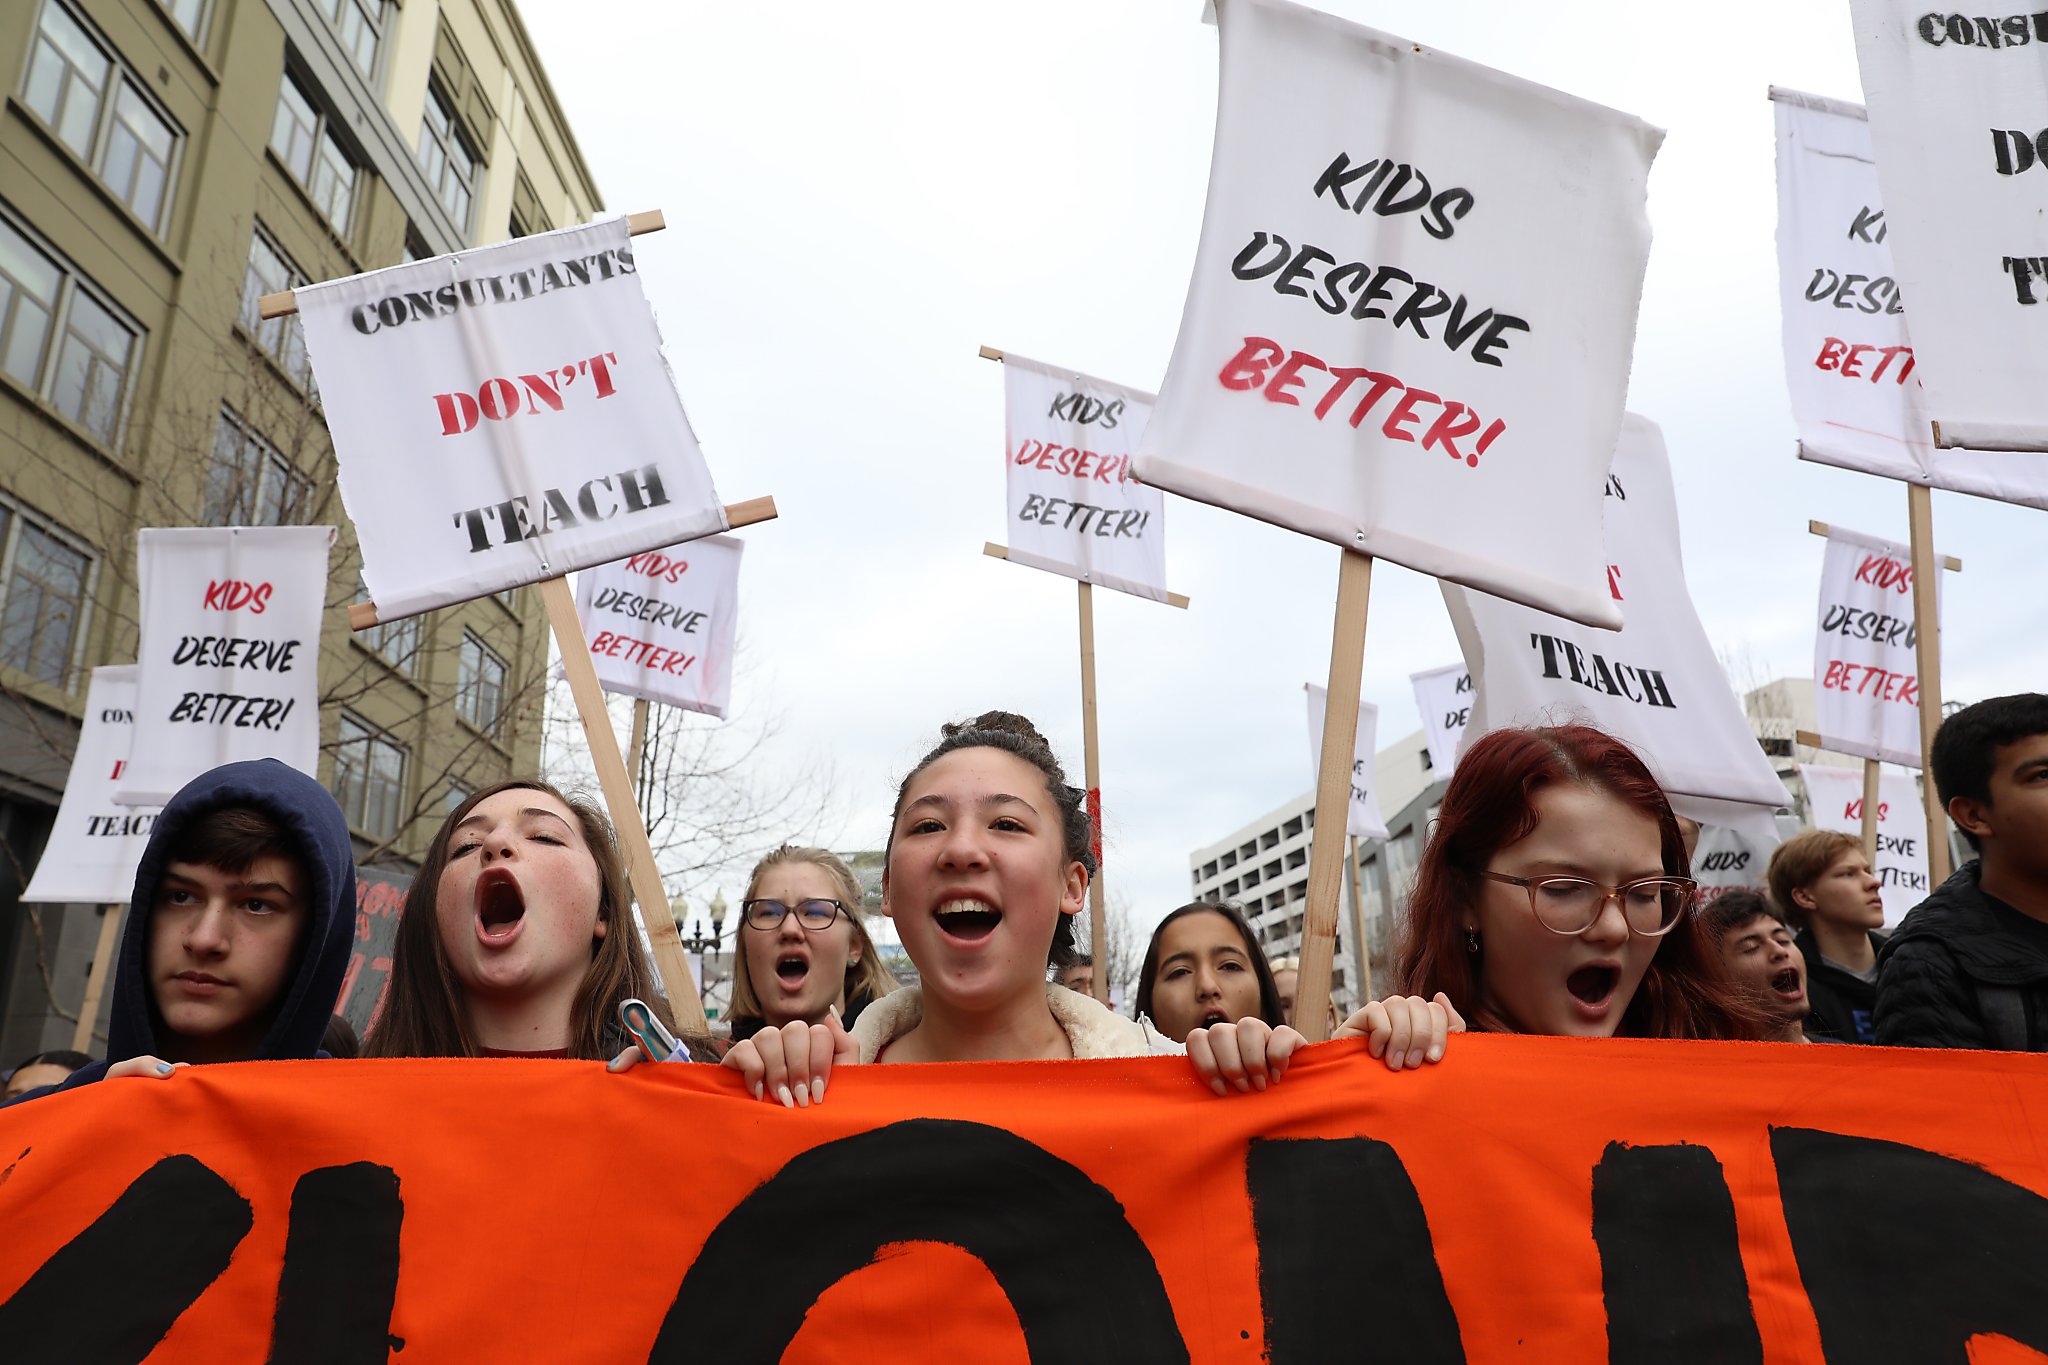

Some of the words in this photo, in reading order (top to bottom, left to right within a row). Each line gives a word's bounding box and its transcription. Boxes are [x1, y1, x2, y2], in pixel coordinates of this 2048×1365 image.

[1313, 151, 1475, 240] KIDS
[352, 245, 637, 336] CONSULTANTS
[1230, 231, 1530, 367] DESERVE
[1815, 337, 1923, 389] BETT
[432, 352, 619, 437] DON'T
[1049, 392, 1126, 429] KIDS
[1218, 336, 1507, 468] BETTER!
[1014, 439, 1142, 486] DESER
[453, 463, 671, 553] TEACH
[1019, 493, 1150, 538] BETTER!
[625, 552, 688, 583] KIDS
[1855, 554, 1914, 594] KIDS
[203, 580, 273, 615] KIDS
[594, 588, 708, 634] DESERVE
[173, 636, 300, 673] DESERVE
[591, 631, 696, 676] BETTER!
[1530, 633, 1677, 709] TEACH
[1823, 660, 1920, 707] BETTER
[169, 691, 294, 732] BETTER!
[1844, 801, 1889, 822] KIS
[1700, 852, 1749, 871] KIDS
